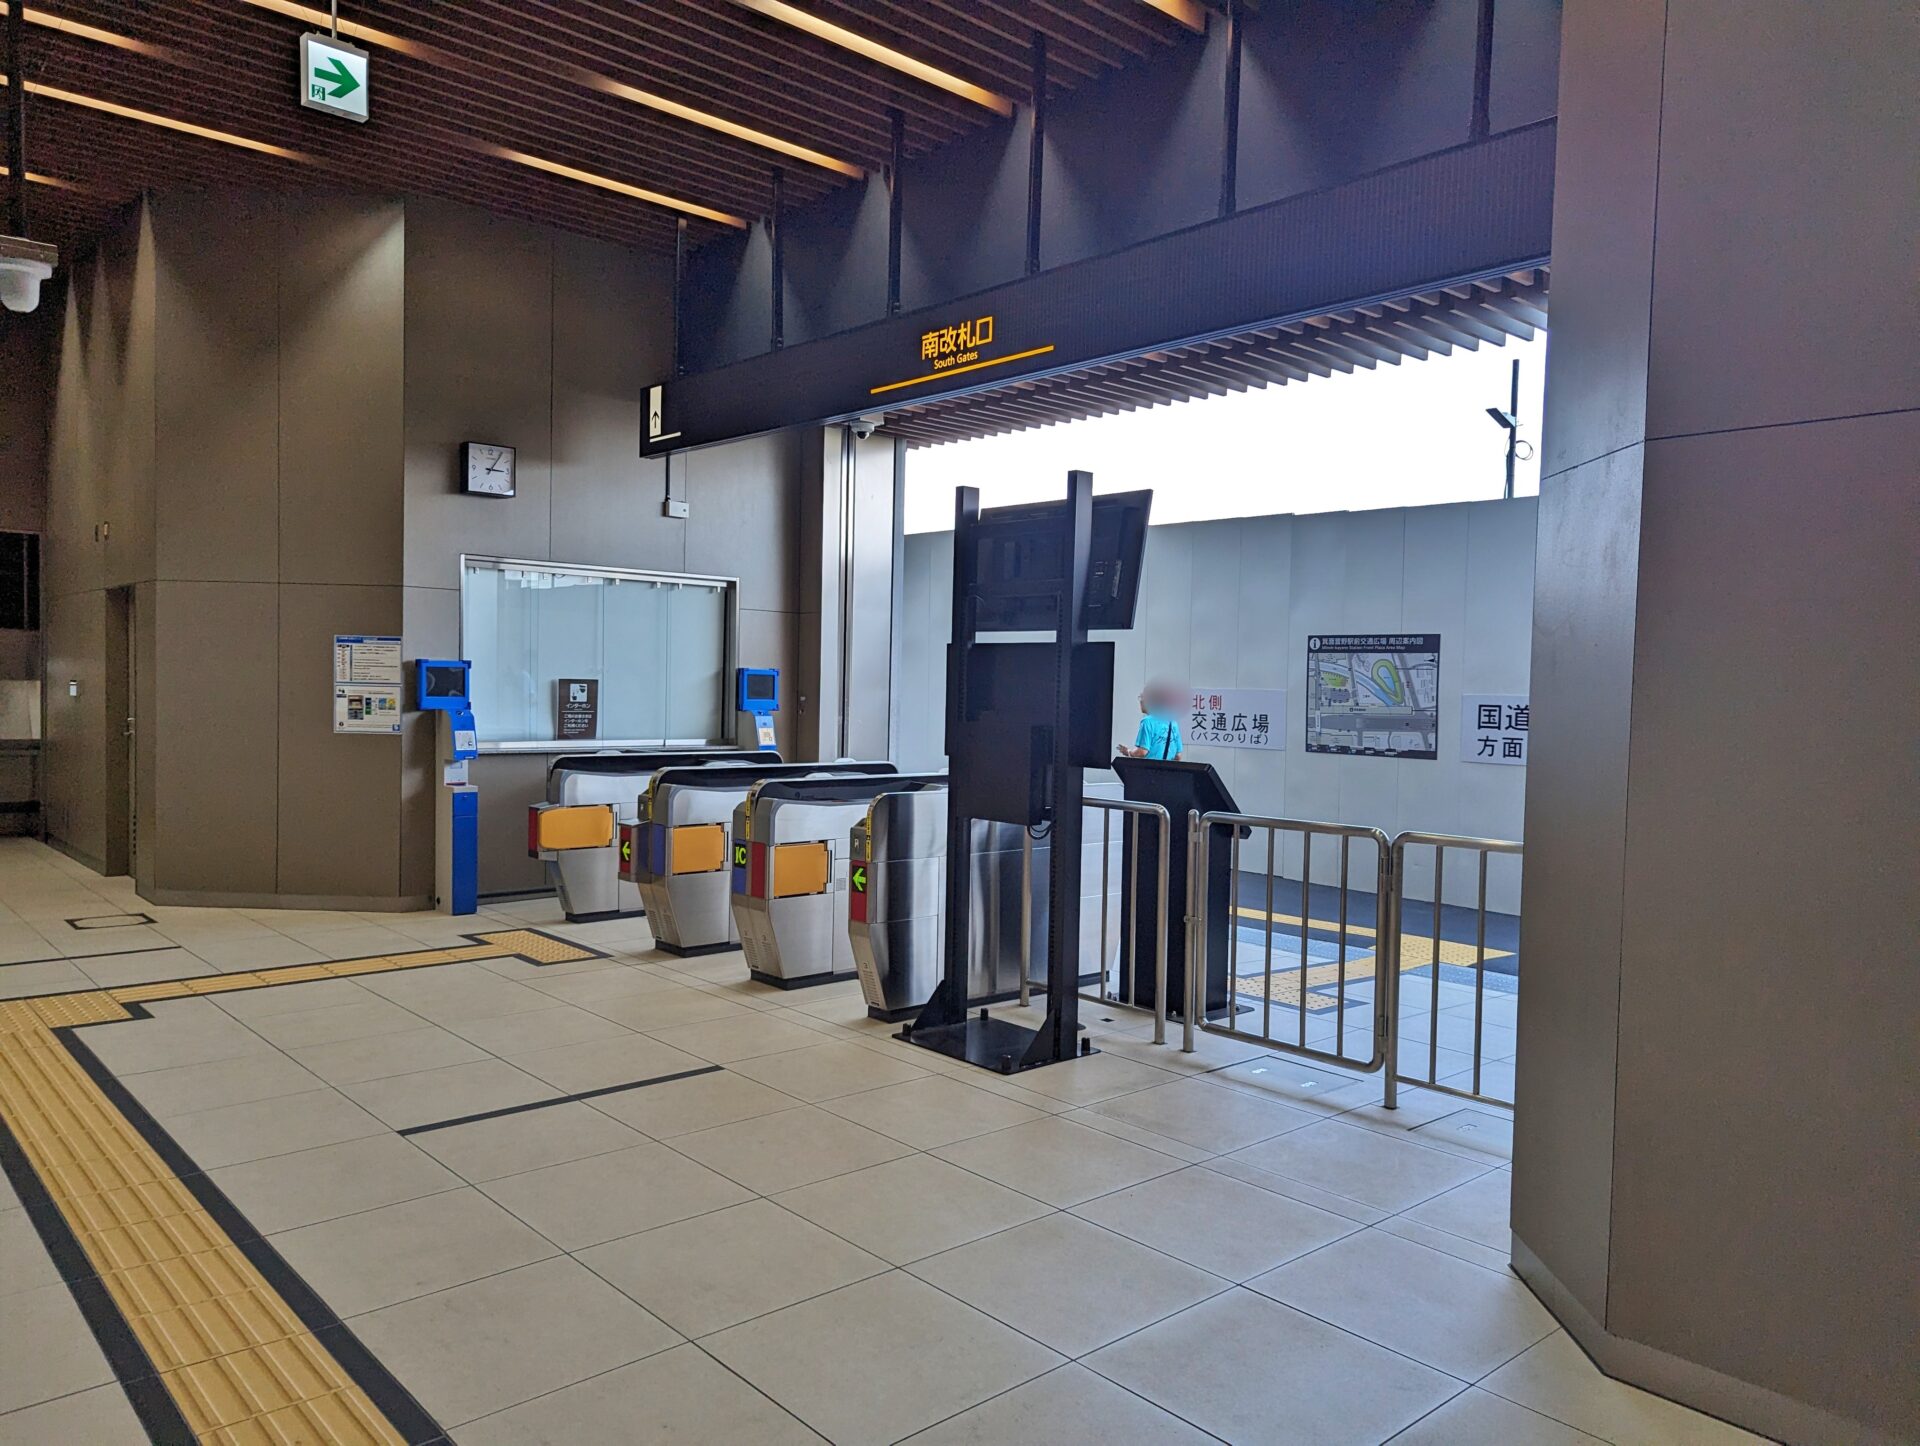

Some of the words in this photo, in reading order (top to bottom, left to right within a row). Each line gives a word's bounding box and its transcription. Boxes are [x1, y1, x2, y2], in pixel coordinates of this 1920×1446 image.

[921, 316, 993, 360] 南改札口
[934, 357, 955, 370] South
[956, 351, 978, 364] Gates
[1192, 694, 1223, 711] 北側
[1191, 711, 1270, 734] 交通広場
[1477, 704, 1529, 731] 国道
[1477, 735, 1524, 759] 方面
[735, 846, 747, 865] IC
